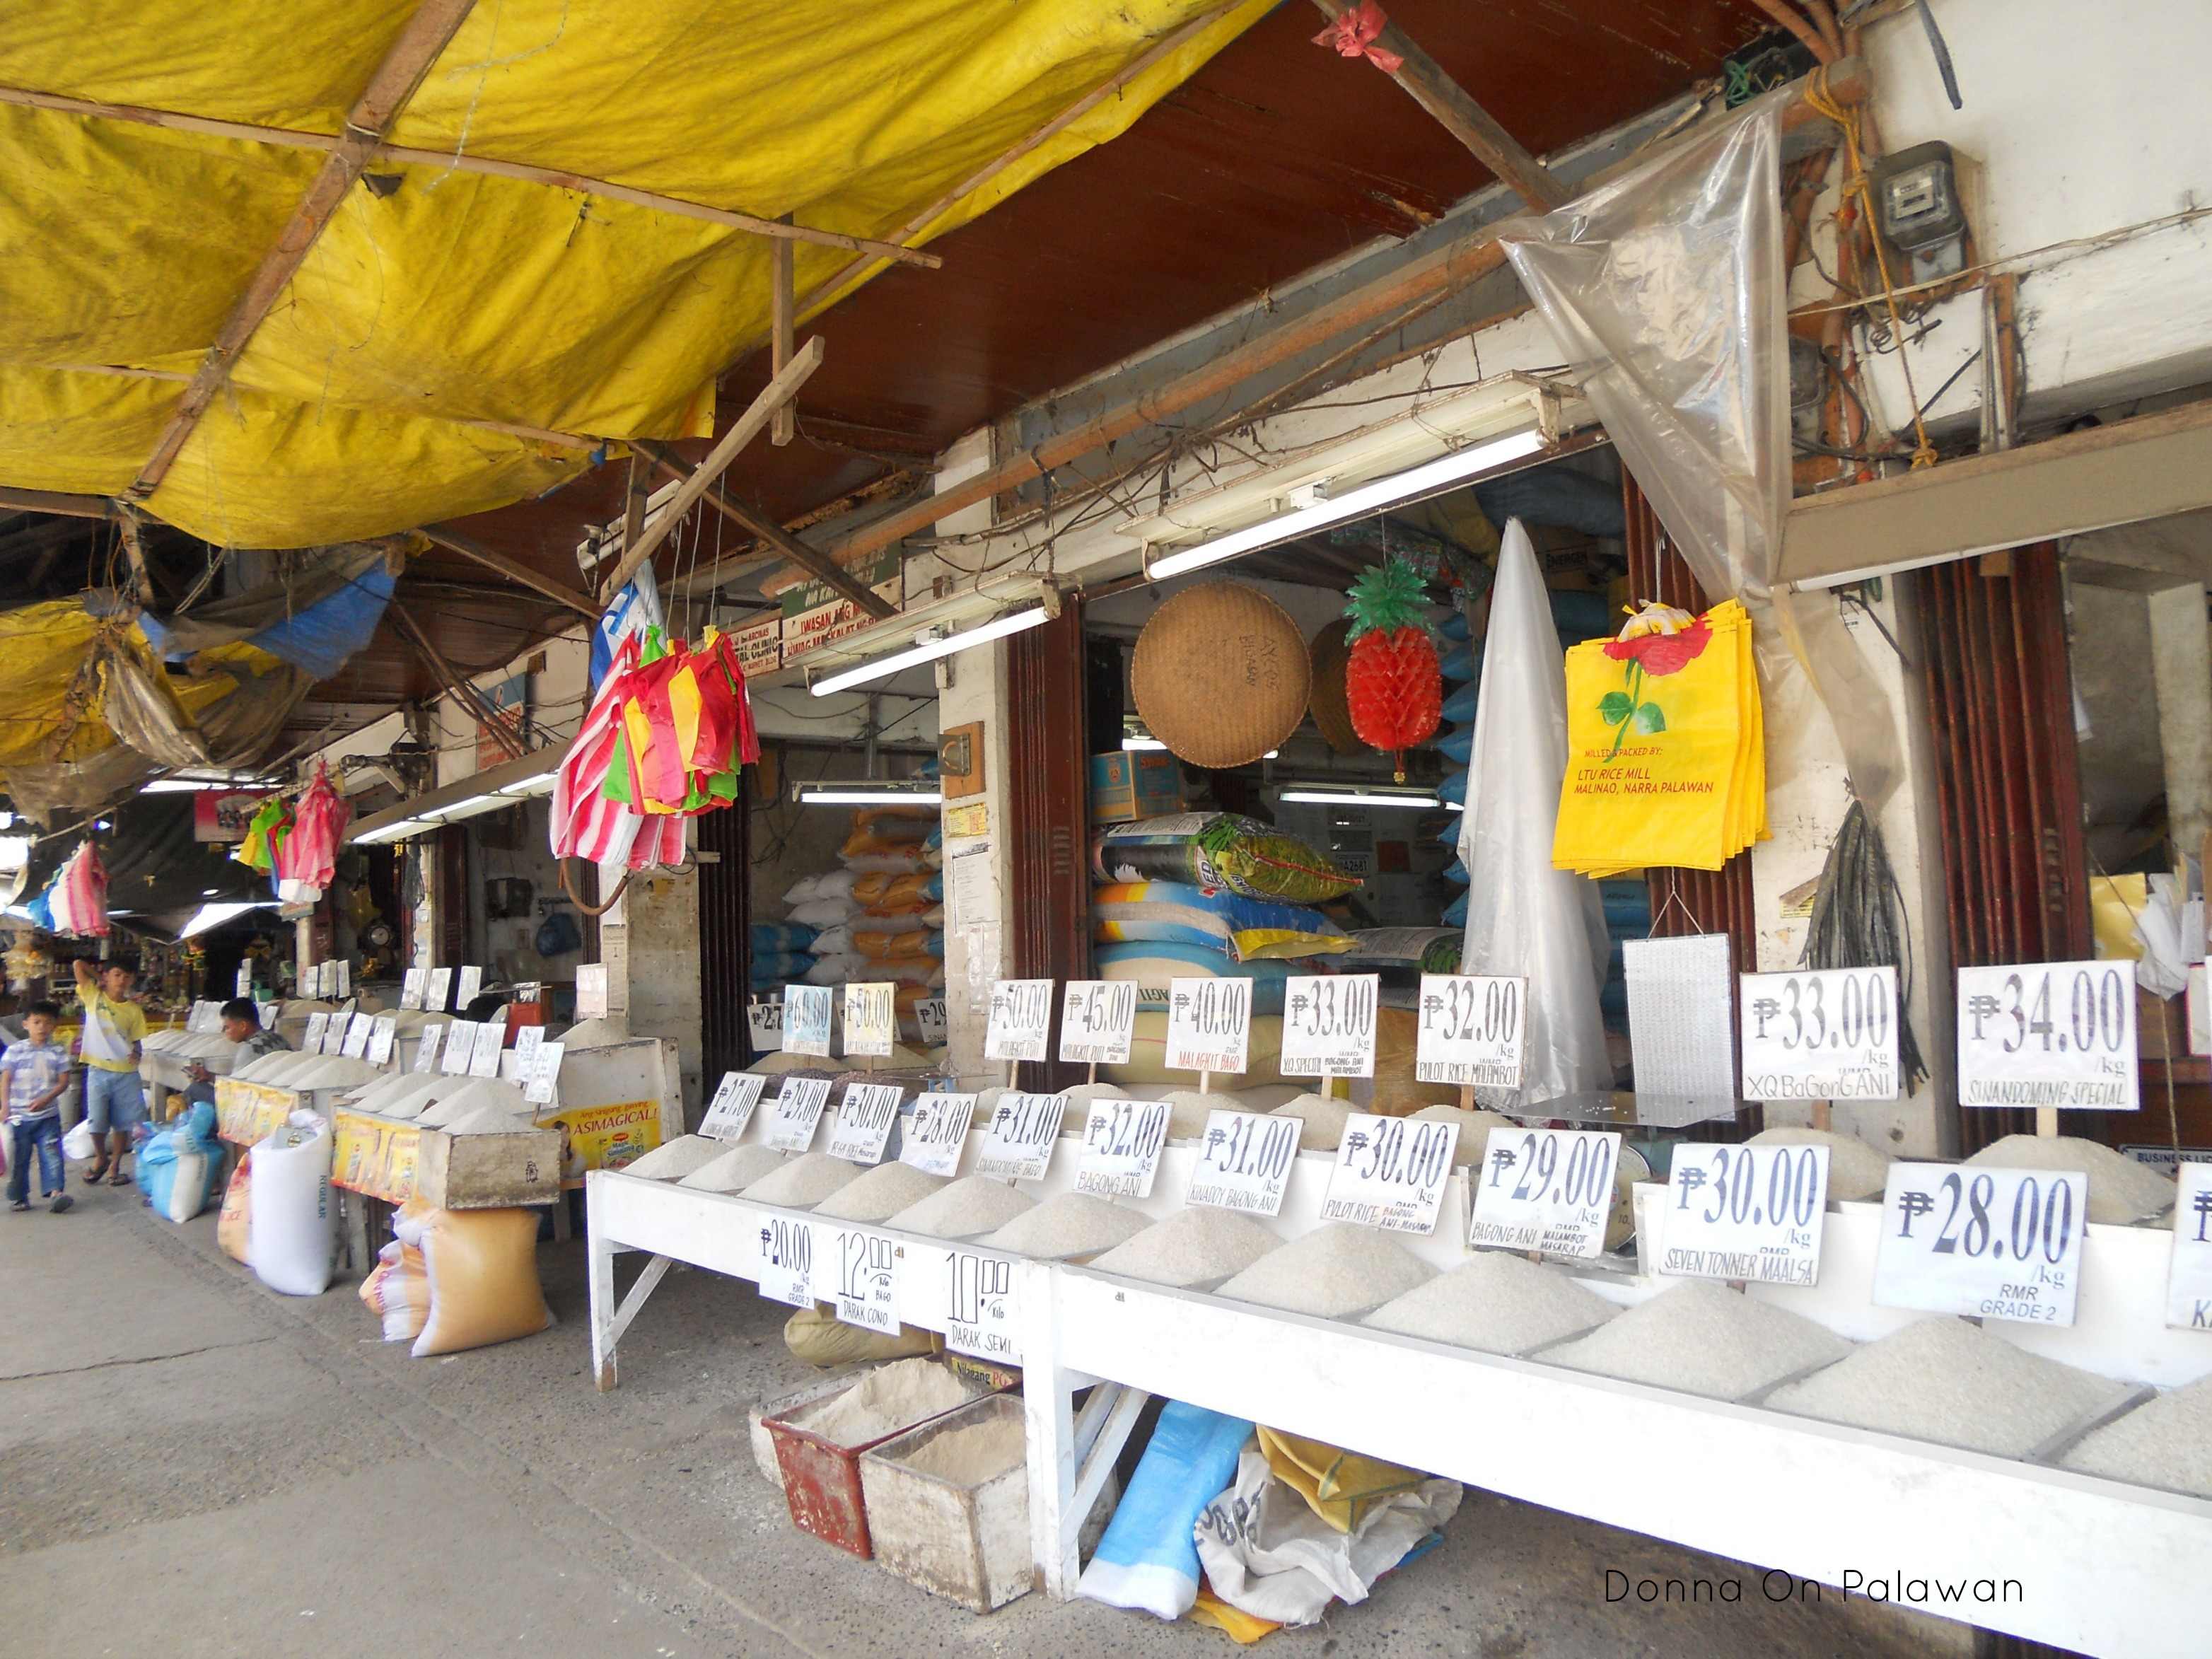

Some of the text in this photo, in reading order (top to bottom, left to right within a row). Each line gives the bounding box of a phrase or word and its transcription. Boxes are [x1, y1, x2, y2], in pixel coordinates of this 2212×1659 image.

[801, 611, 831, 634] IWASAN
[1584, 748, 1609, 758] MILLED
[1619, 747, 1648, 757] PACKED
[1648, 746, 1663, 756] BY:
[1574, 781, 1713, 795] MALINAO, NARRA PALAWAN
[1578, 767, 1651, 781] LTU RICE MILL
[1291, 979, 1372, 1036] ₱33.00
[1424, 979, 1517, 1043] ₱32.00
[1753, 973, 1888, 1050] ₱33.00
[1969, 969, 2125, 1053] ₱34.00
[2070, 1081, 2126, 1105] SPECIAL
[573, 1107, 658, 1136] ASIMAGICAL!
[1088, 1102, 1165, 1158] ₱32.00
[1204, 1116, 1294, 1180] ₱31.00
[1343, 1118, 1448, 1188] ₱30.00
[1488, 1133, 1610, 1208] ₱29.00
[1677, 1148, 1818, 1227] ₱30.00
[1897, 1172, 2073, 1264] ₱28.00
[761, 1218, 811, 1274] ₱20.00
[1515, 1227, 1538, 1245] ANI
[1664, 1247, 1706, 1273] SEVEN
[1707, 1251, 1758, 1277] TONNER
[2030, 1264, 2066, 1290] /kg
[1999, 1283, 2039, 1301] RMR
[844, 1300, 888, 1326] DARAK CONO
[1979, 1298, 2056, 1321] GRADE 2
[952, 1324, 1011, 1355] DARAK SEMI
